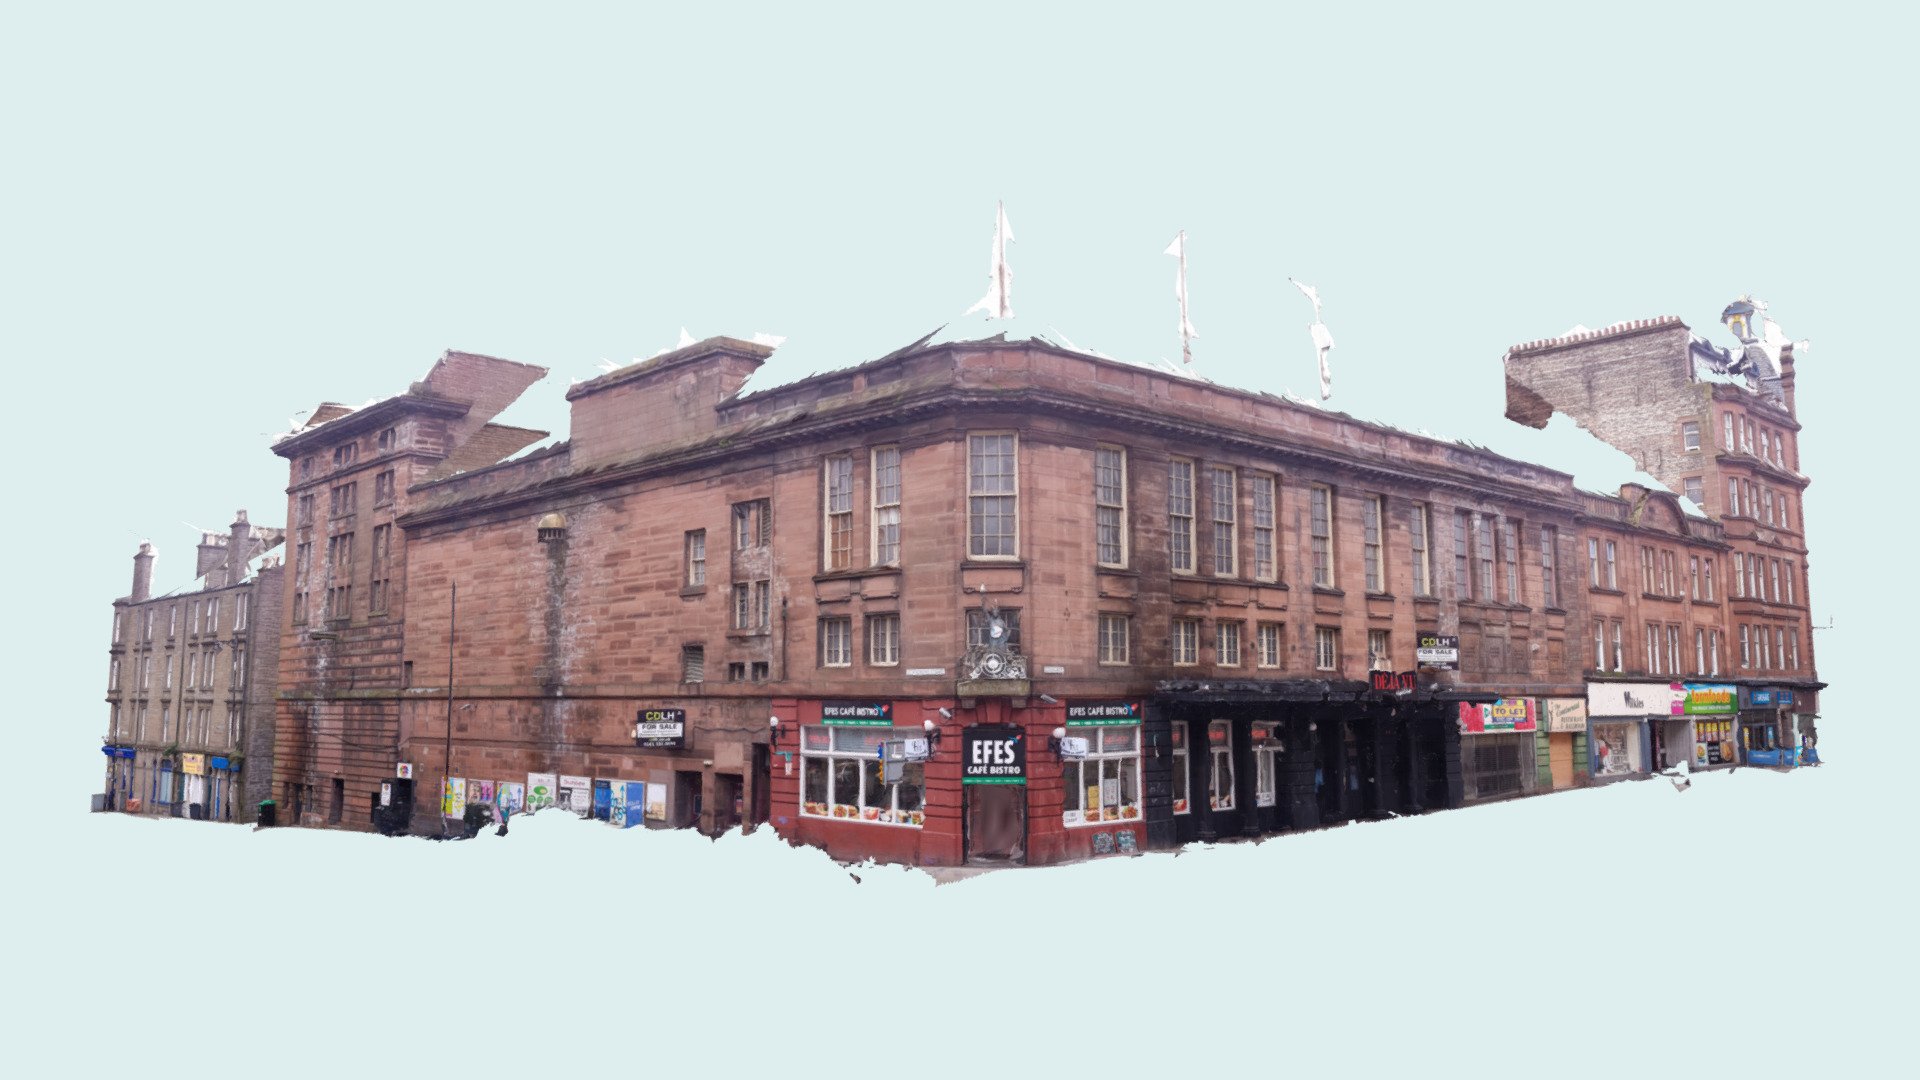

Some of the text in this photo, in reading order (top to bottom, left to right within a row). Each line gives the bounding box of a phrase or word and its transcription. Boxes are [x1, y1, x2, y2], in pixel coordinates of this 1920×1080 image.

[1421, 637, 1450, 646] CDLH
[646, 711, 674, 720] CDLH
[824, 706, 879, 716] EFES CAFÉ BISTRO
[1069, 705, 1128, 716] EFES CAFÉ BISTRO
[972, 739, 1016, 764] EFES
[967, 763, 1021, 775] CAFÉ BISTRO
